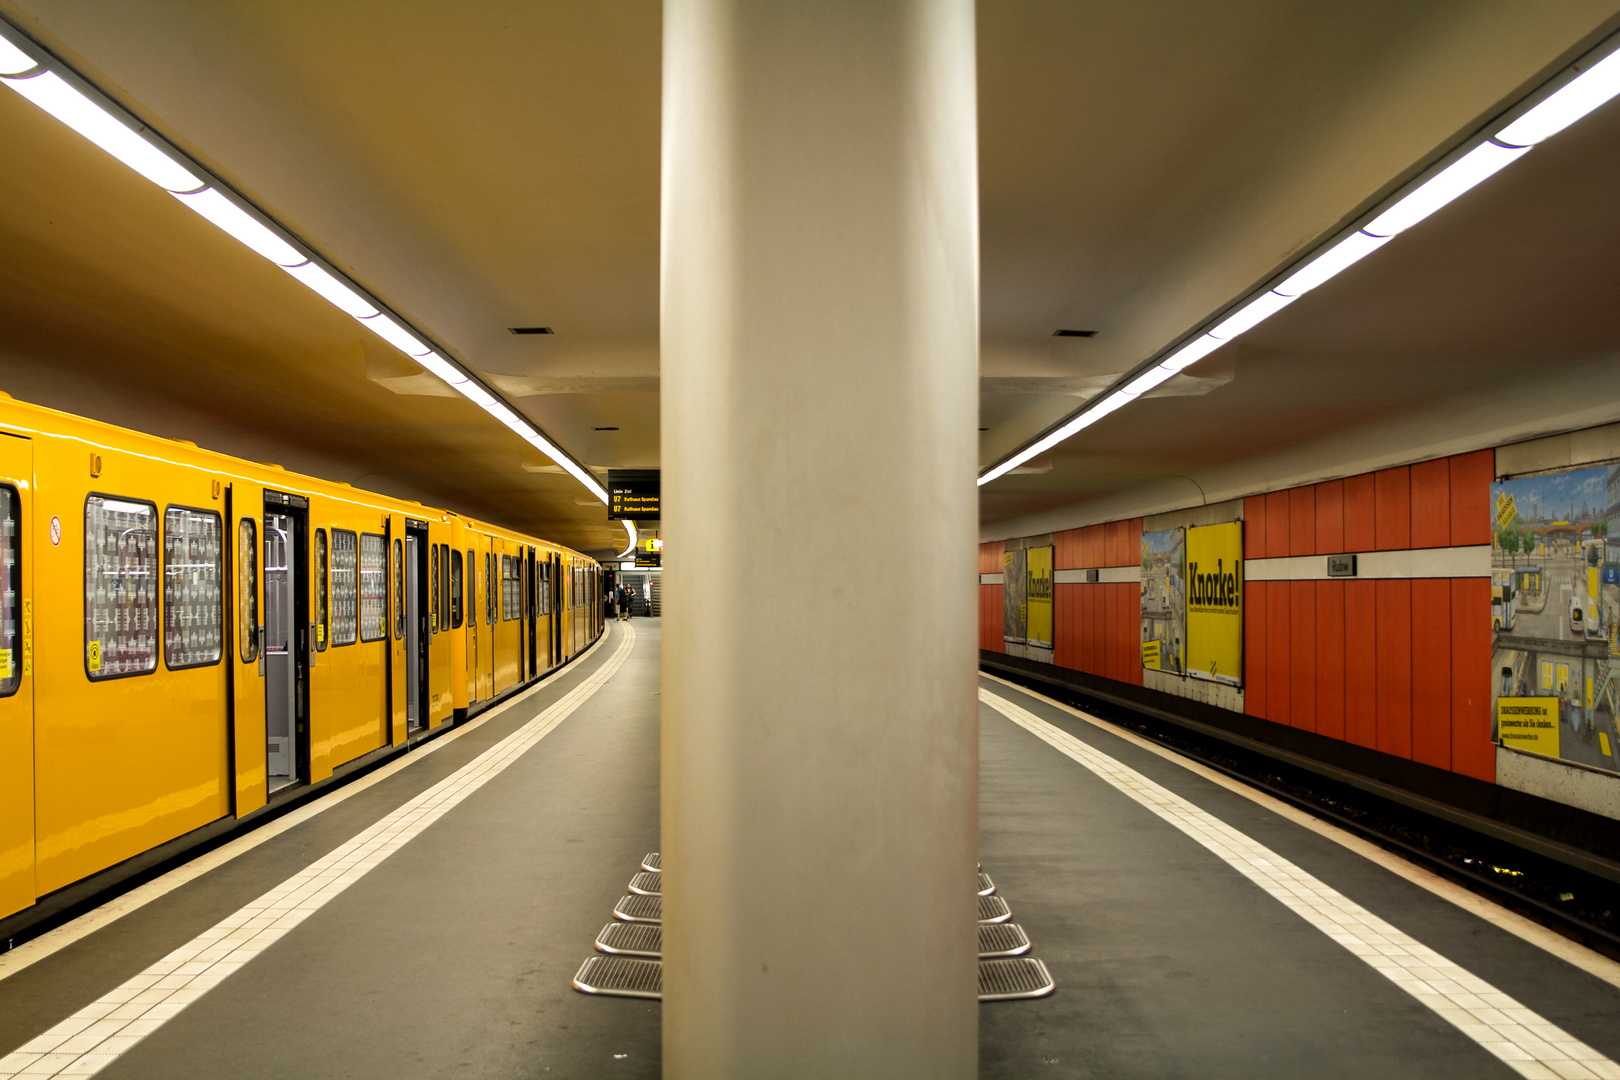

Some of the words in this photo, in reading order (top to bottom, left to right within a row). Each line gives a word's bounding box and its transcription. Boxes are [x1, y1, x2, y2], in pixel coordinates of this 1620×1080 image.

[613, 495, 621, 503] U7
[613, 505, 621, 513] U7
[1332, 560, 1349, 572] Rudow
[1028, 569, 1052, 599] Knorke!
[1189, 558, 1239, 607] Knorke!
[1501, 706, 1541, 715] DRAUSSENWERBUNG
